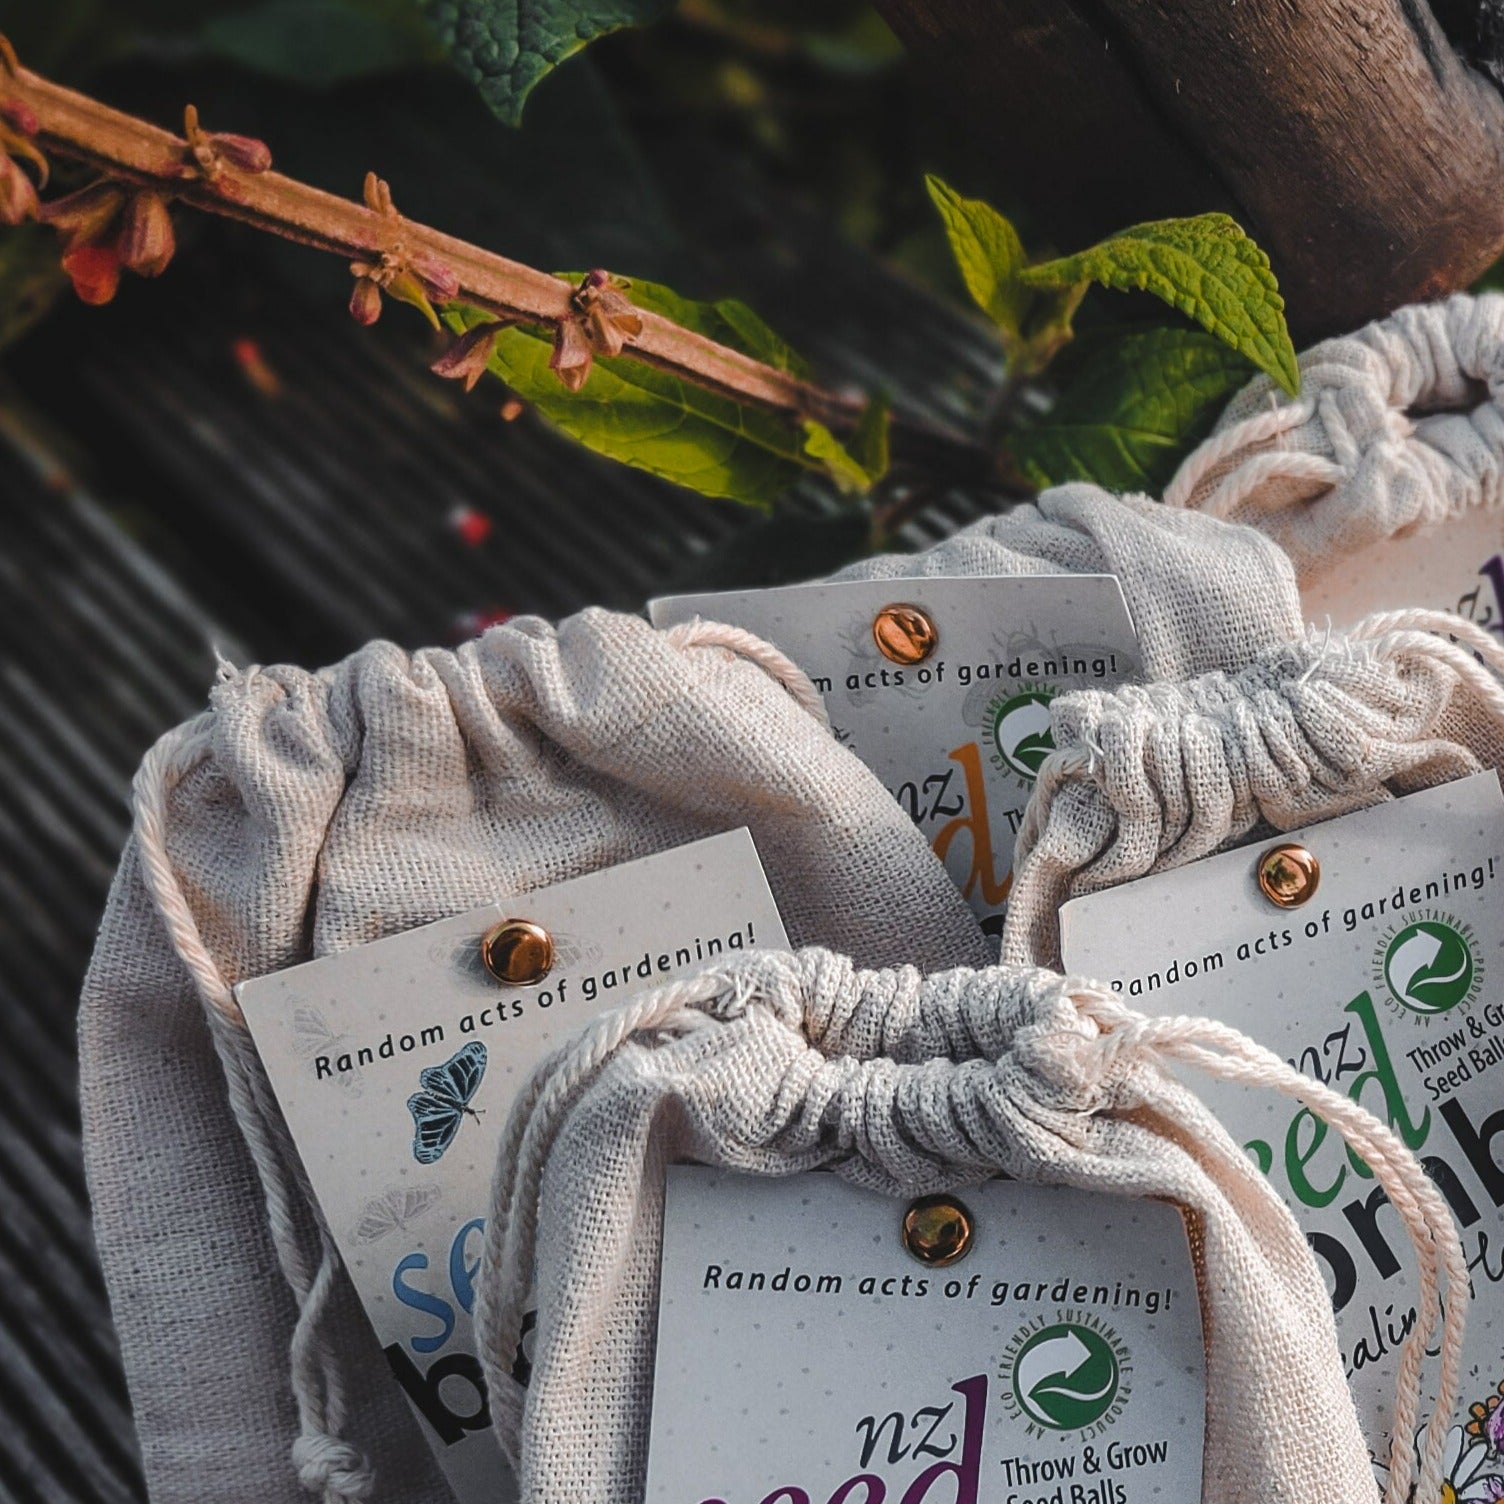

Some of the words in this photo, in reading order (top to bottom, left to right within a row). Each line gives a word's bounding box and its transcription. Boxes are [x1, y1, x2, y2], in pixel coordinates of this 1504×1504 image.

[845, 668, 904, 690] acts
[917, 661, 945, 685] of
[958, 654, 1118, 686] gardening!
[1236, 927, 1293, 961] acts
[1304, 910, 1332, 939] of
[1342, 858, 1497, 931] gardening!
[314, 1022, 447, 1082] Random
[458, 998, 525, 1036] acts
[537, 977, 569, 1011] of
[581, 921, 758, 1002] gardening!
[1405, 1028, 1467, 1074] Throw
[1465, 1015, 1487, 1039] &
[1243, 990, 1432, 1209] ed
[1423, 1057, 1473, 1102] Seed
[703, 1264, 843, 1294] Random
[857, 1273, 929, 1298] acts
[943, 1274, 981, 1299] of
[990, 1279, 1173, 1315] gardening!
[997, 1314, 1047, 1380] FRIENDLY
[1056, 1308, 1134, 1374] SUSTAINABLE
[855, 1401, 958, 1470] nz
[1079, 1385, 1132, 1443] PRODUCT
[1000, 1455, 1076, 1488] Throw
[1082, 1445, 1102, 1475] &
[1106, 1440, 1169, 1471] Grow
